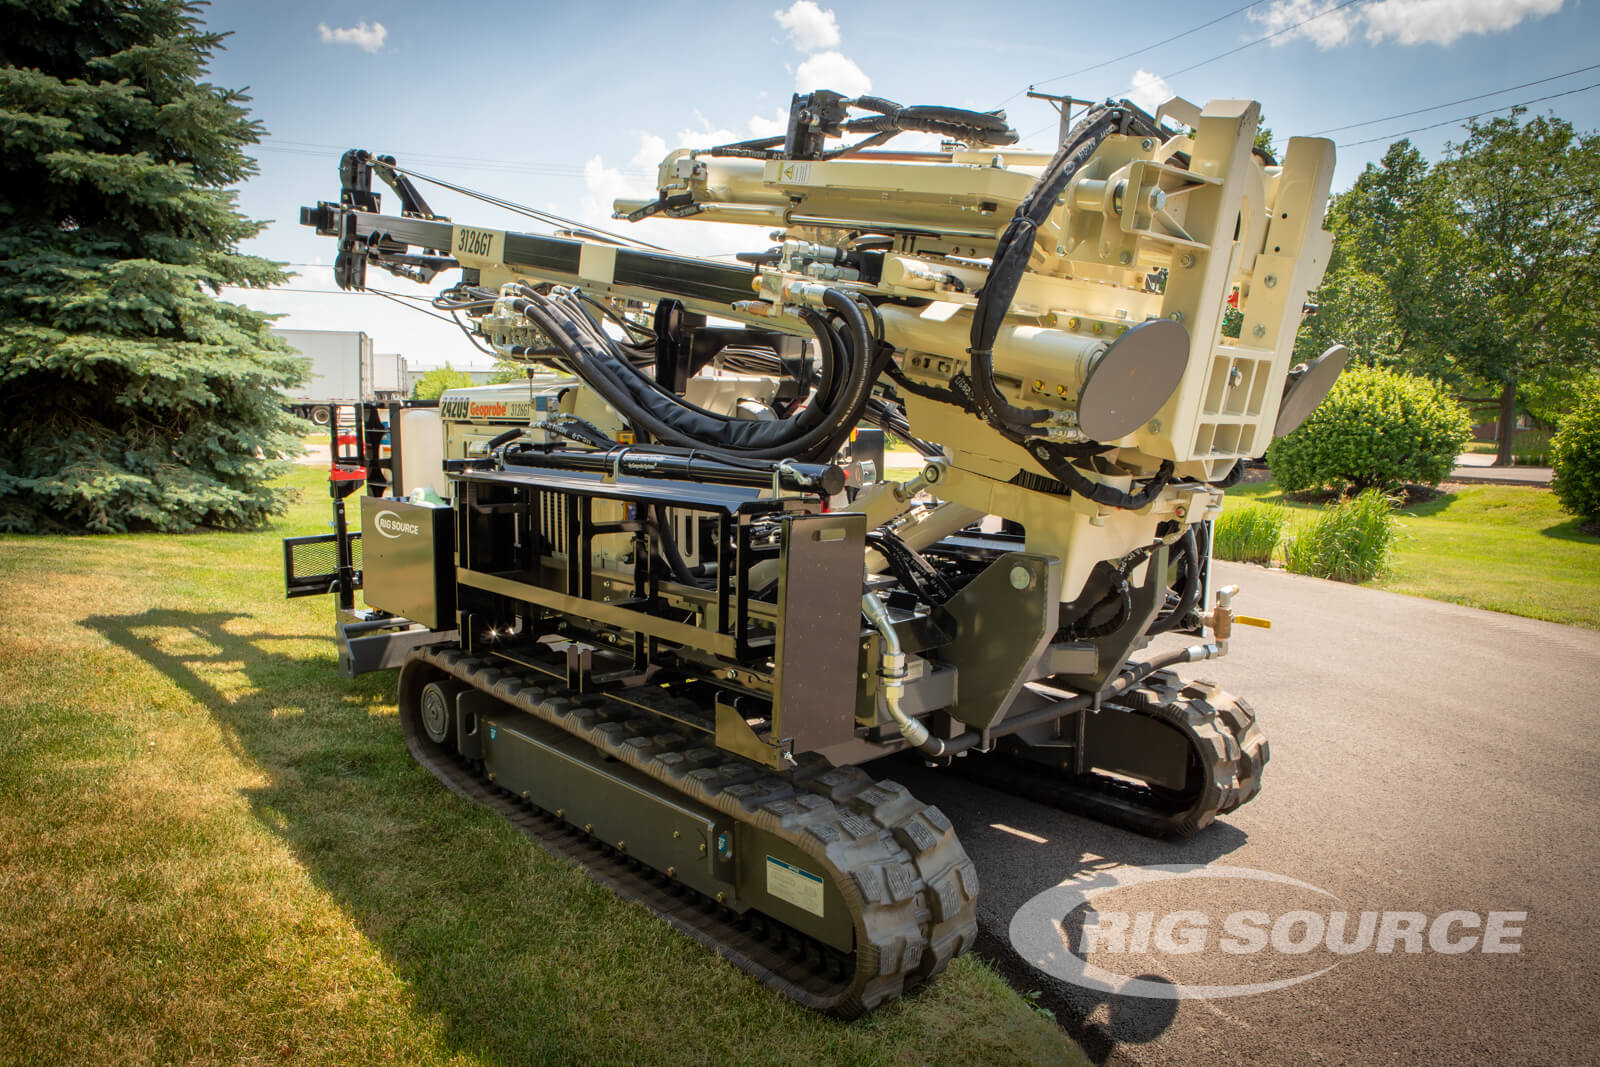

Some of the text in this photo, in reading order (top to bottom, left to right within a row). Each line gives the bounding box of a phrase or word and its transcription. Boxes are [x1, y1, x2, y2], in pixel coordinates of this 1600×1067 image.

[459, 229, 494, 256] 3126GT
[441, 398, 469, 418] 24209
[510, 403, 530, 417] 3126GT
[380, 518, 419, 535] RIG SOURCE
